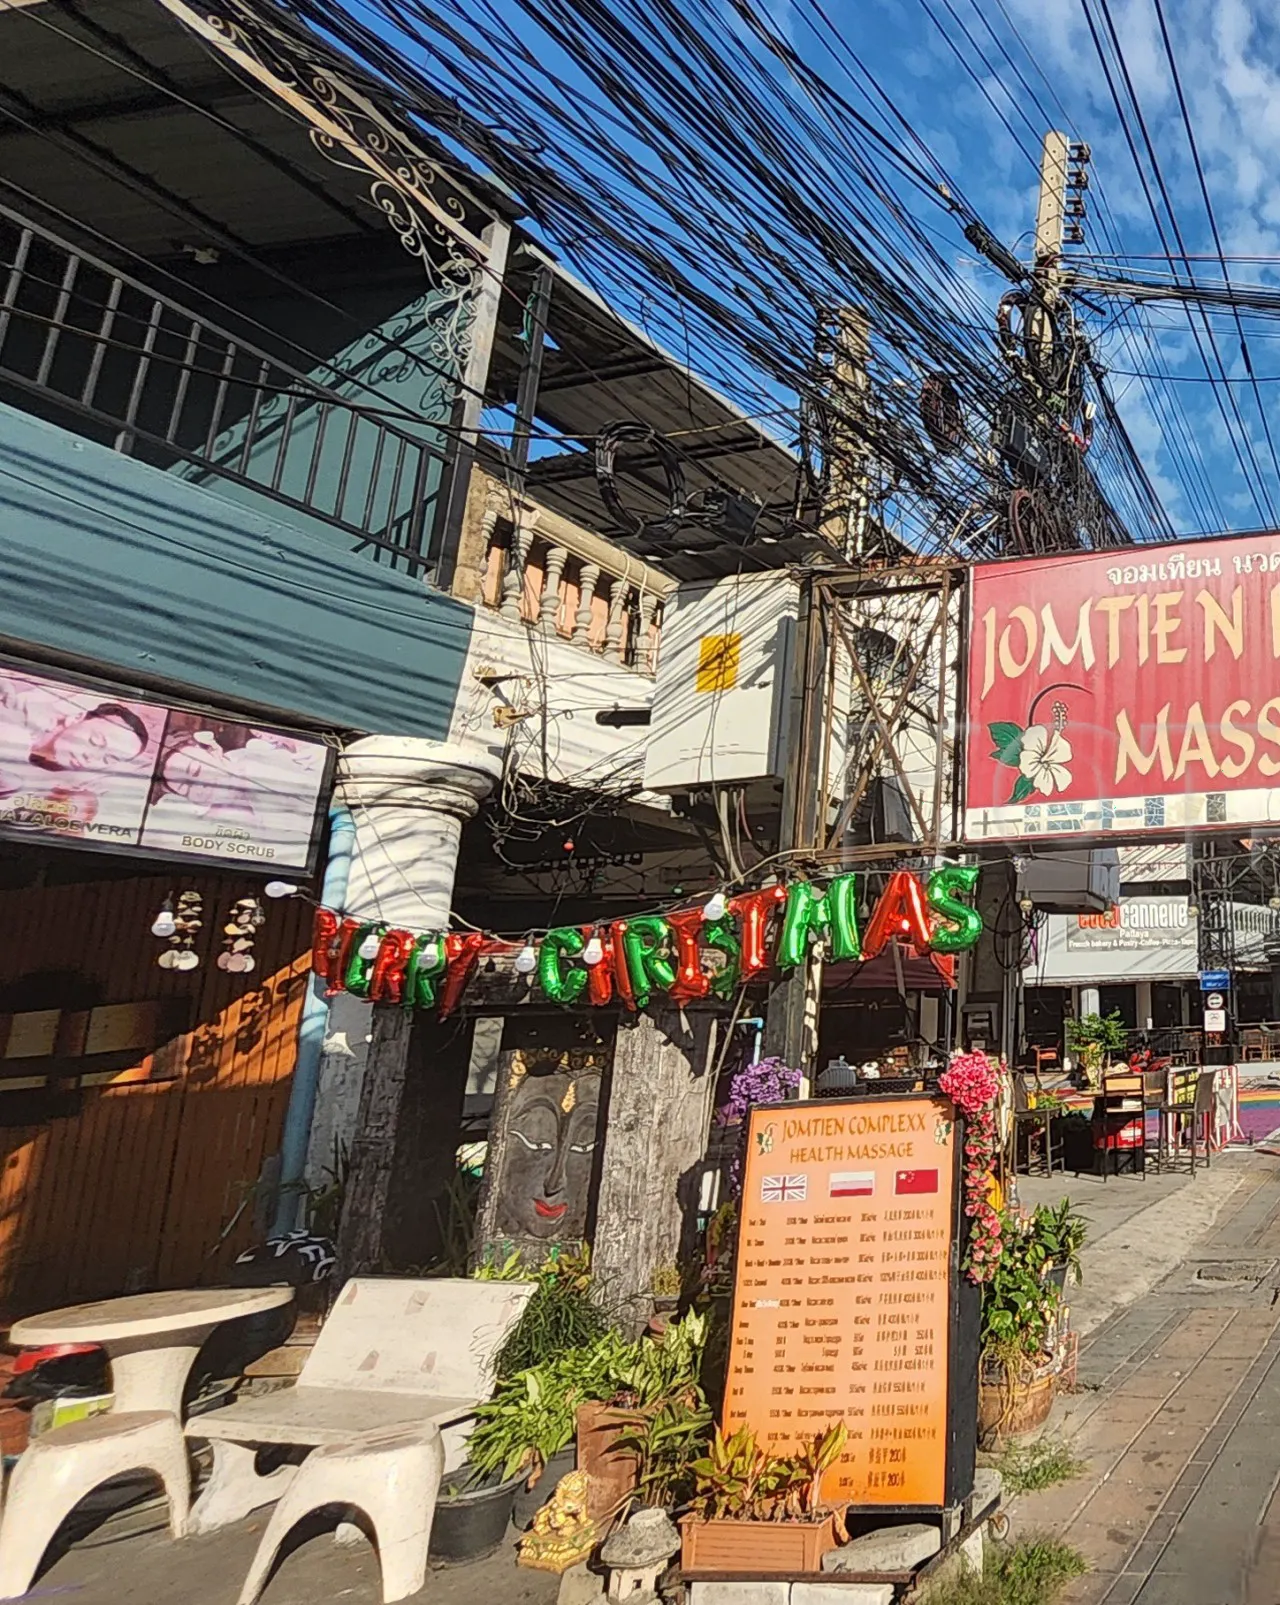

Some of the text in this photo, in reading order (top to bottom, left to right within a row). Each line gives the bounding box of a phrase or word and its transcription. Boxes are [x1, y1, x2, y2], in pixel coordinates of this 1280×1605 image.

[1107, 553, 1222, 586] จอมเทียน
[982, 584, 1244, 700] JOMTIEN
[33, 814, 83, 832] ALOE
[84, 822, 132, 838] VERA
[182, 836, 275, 858] BODY SCRUB
[782, 1113, 926, 1143] JOMTIEN COMPLEXX
[789, 1142, 914, 1163] HEALTH MASSAGE
